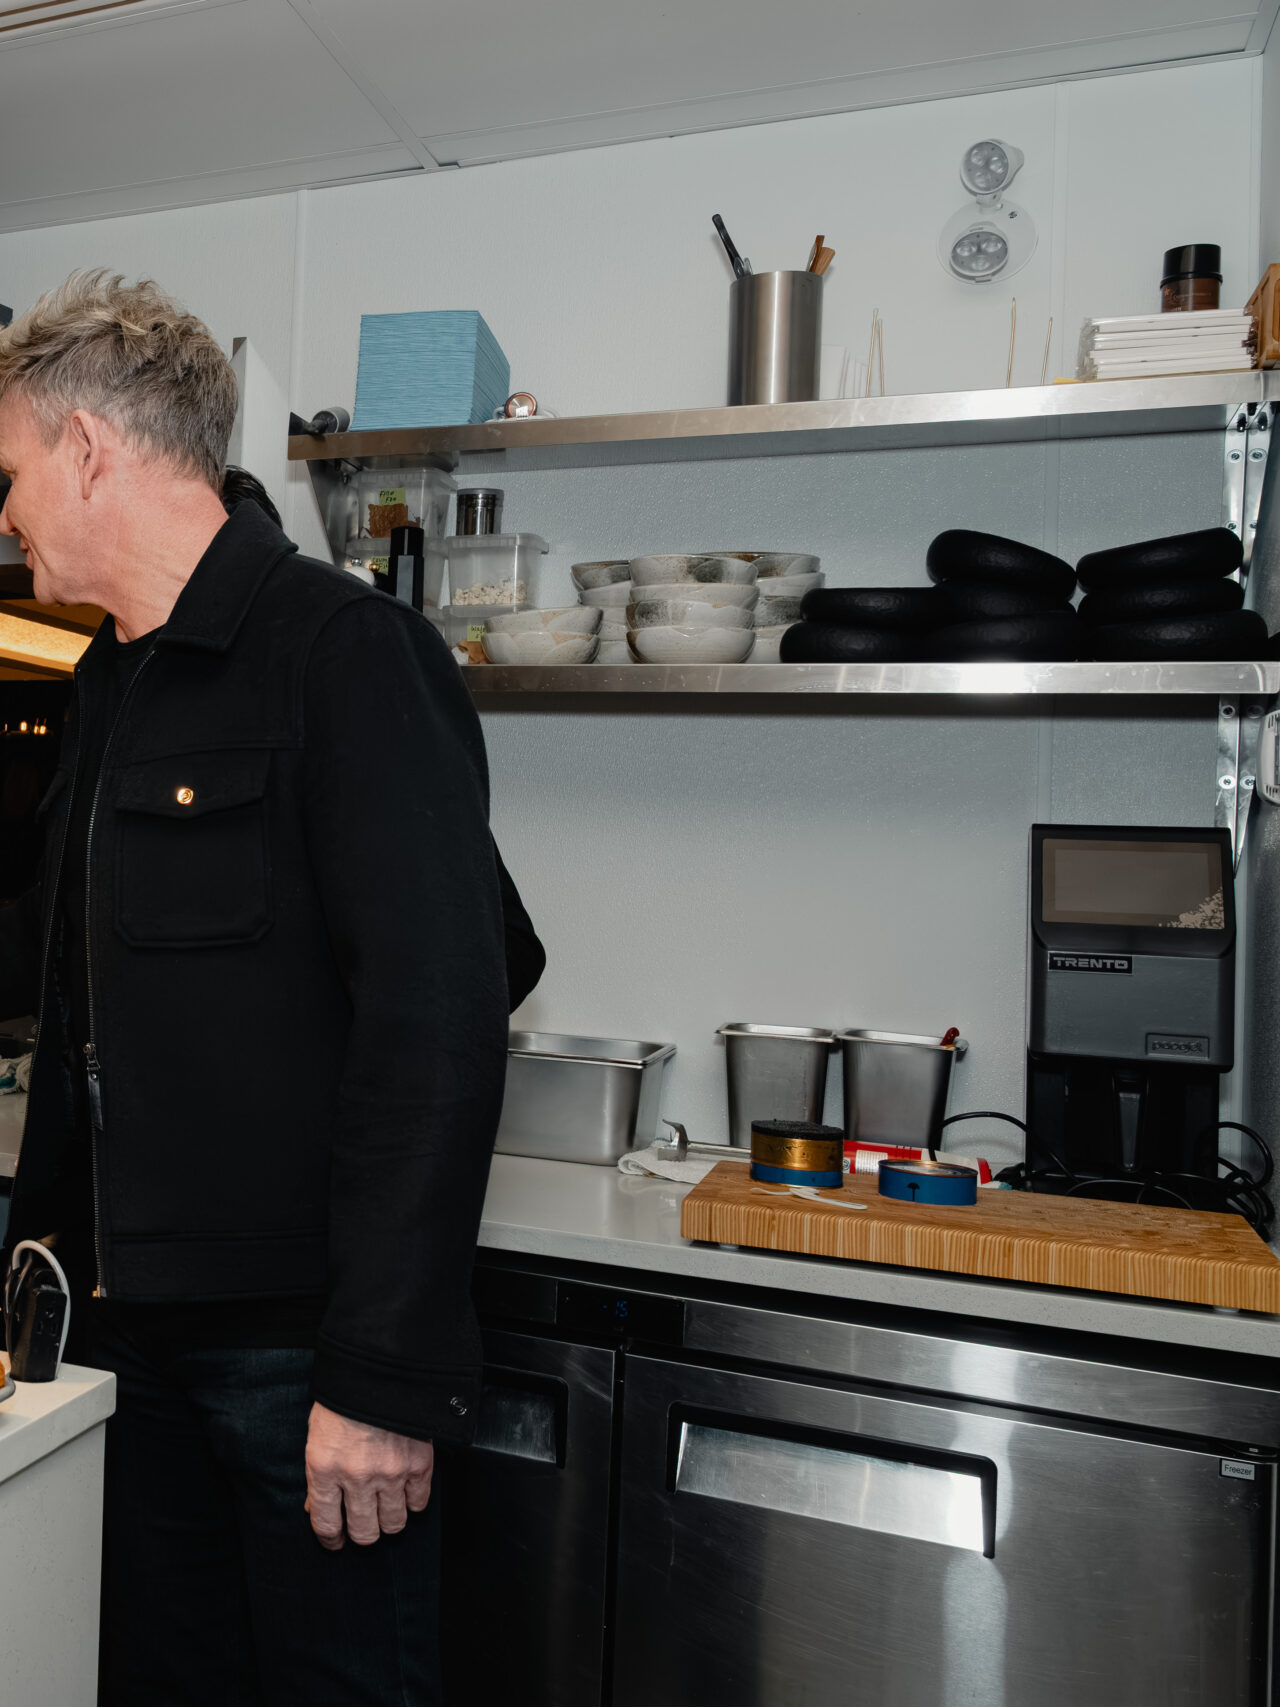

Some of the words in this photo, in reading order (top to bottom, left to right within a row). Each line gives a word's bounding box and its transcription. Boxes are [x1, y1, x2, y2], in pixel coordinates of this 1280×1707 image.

[1052, 956, 1129, 970] TRENTO
[1151, 1039, 1204, 1053] pacojet
[1224, 1464, 1253, 1476] Freezer
